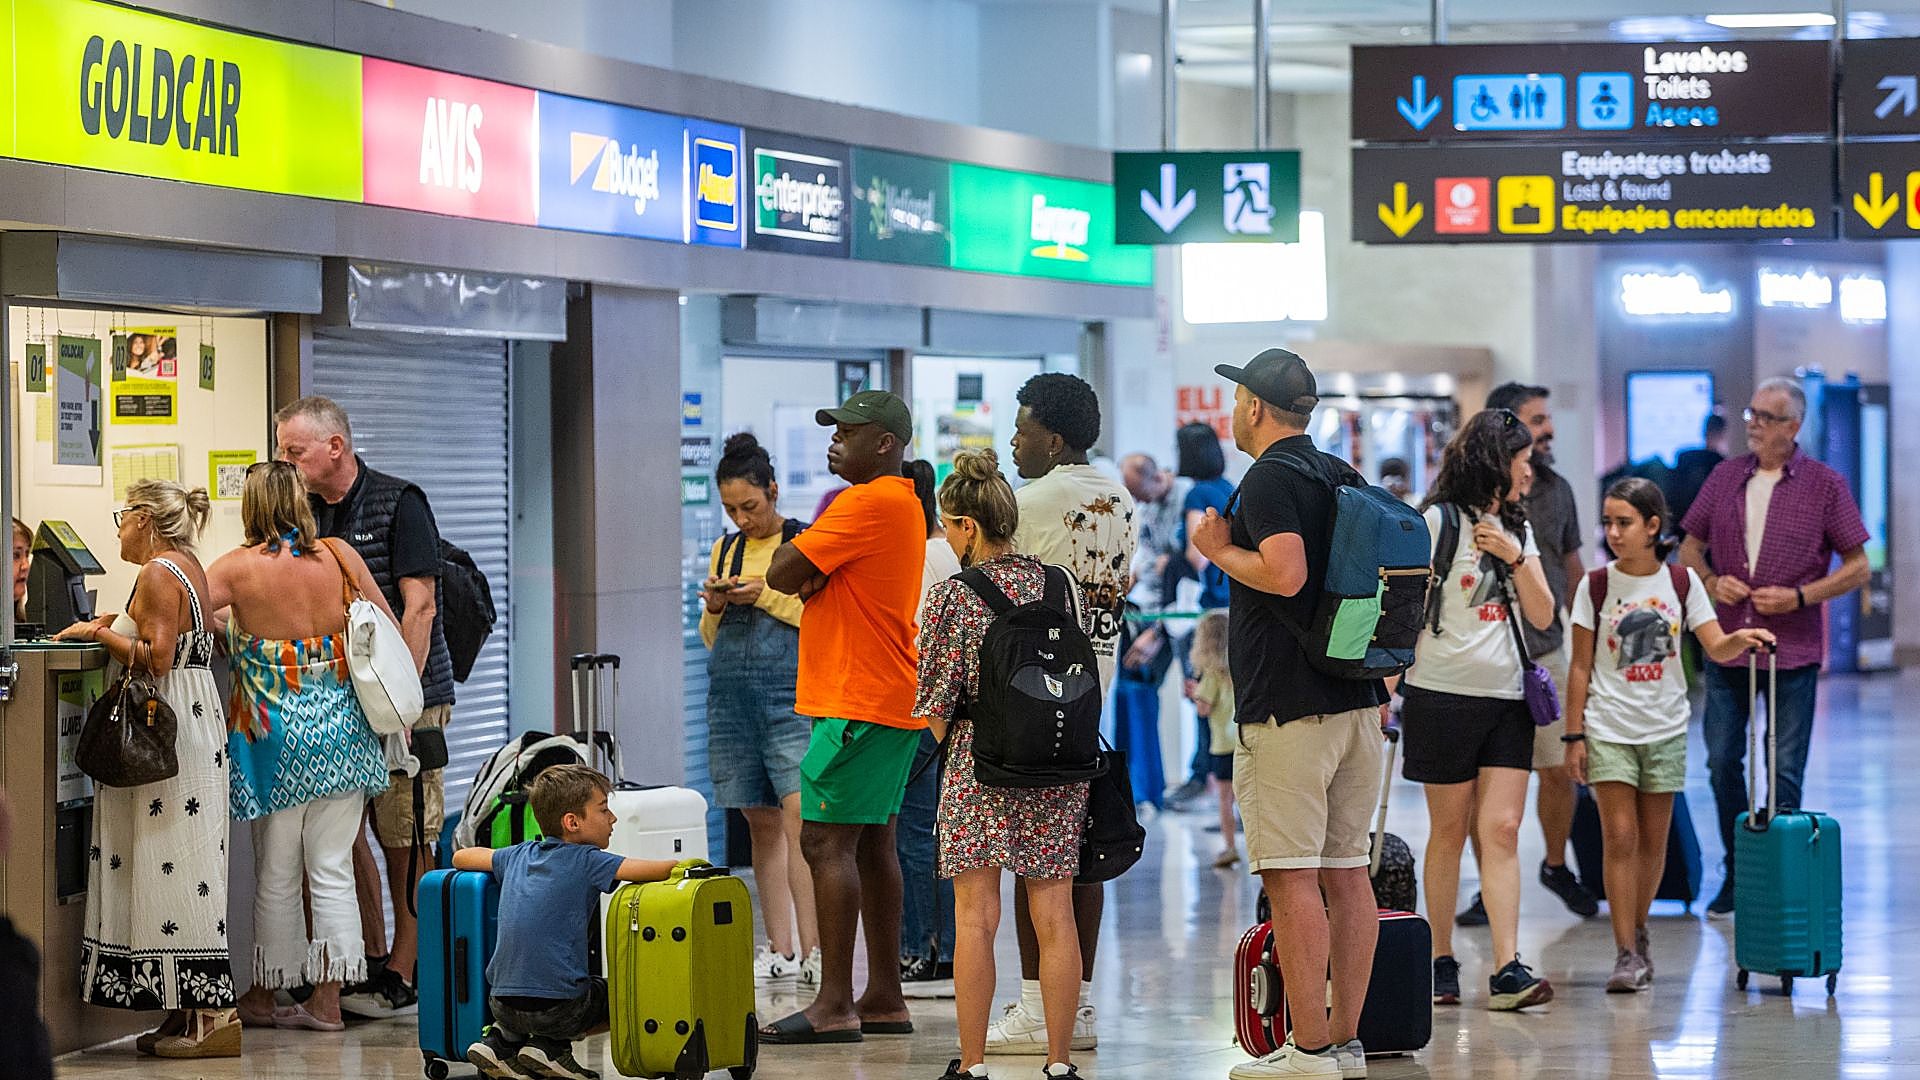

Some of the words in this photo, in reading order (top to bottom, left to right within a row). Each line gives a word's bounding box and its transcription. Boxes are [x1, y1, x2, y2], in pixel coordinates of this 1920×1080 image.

[1644, 46, 1748, 74] Lavabos
[80, 35, 241, 157] GOLDCAR
[1644, 75, 1712, 99] Toilets
[419, 96, 483, 194] AVIS
[607, 139, 659, 216] Budget
[1562, 151, 1687, 179] Equipatges
[1690, 150, 1771, 174] trobats
[1563, 180, 1600, 201] Lost
[1602, 180, 1619, 201] &
[1621, 180, 1672, 201] found
[1562, 205, 1670, 234] Equipajes
[1674, 203, 1815, 229] encontrados
[30, 355, 43, 382] 01
[115, 346, 125, 371] 02
[203, 355, 213, 380] 03
[61, 716, 81, 736] LLAVES
